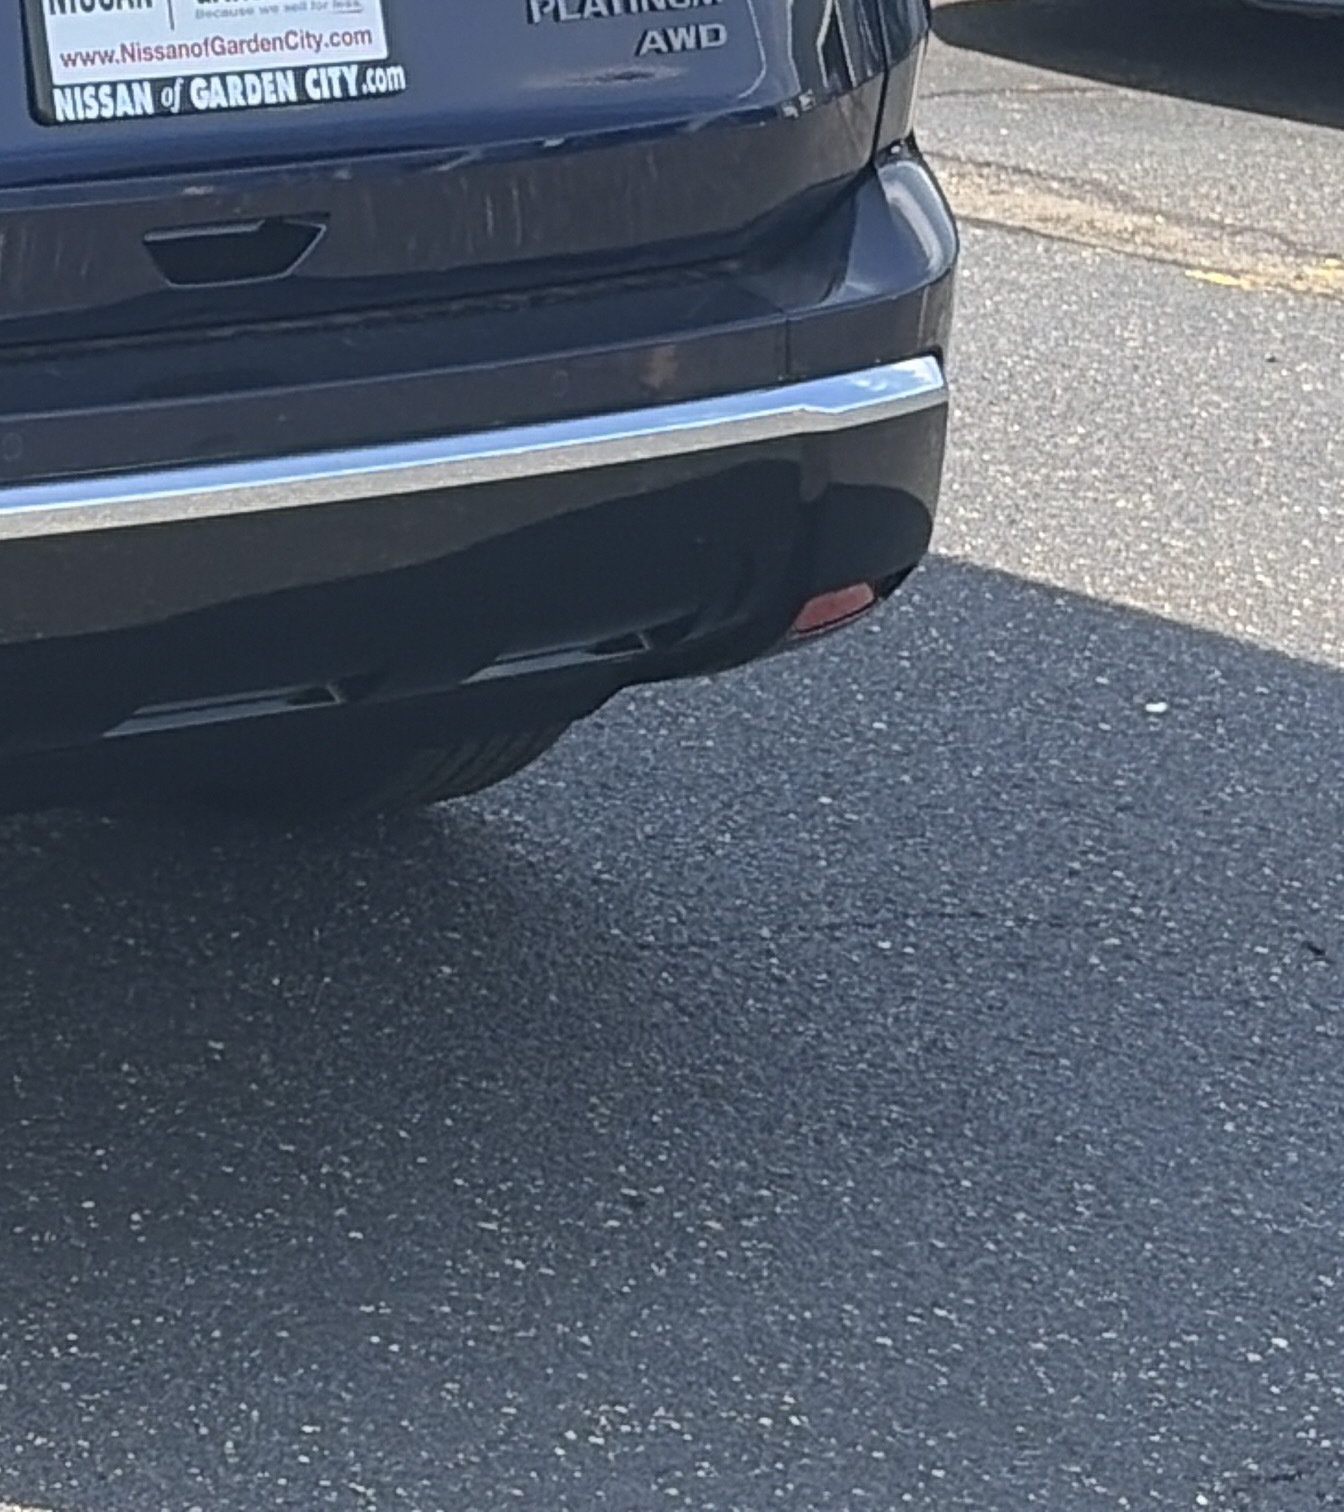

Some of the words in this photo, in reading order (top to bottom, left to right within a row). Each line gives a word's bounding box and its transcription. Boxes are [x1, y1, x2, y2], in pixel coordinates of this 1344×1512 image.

[59, 28, 373, 68] www.NissanofGardenCity.com
[636, 22, 728, 56] AWD
[52, 80, 155, 123] NISSAN
[161, 77, 184, 113] of
[189, 69, 299, 110] GARDEN
